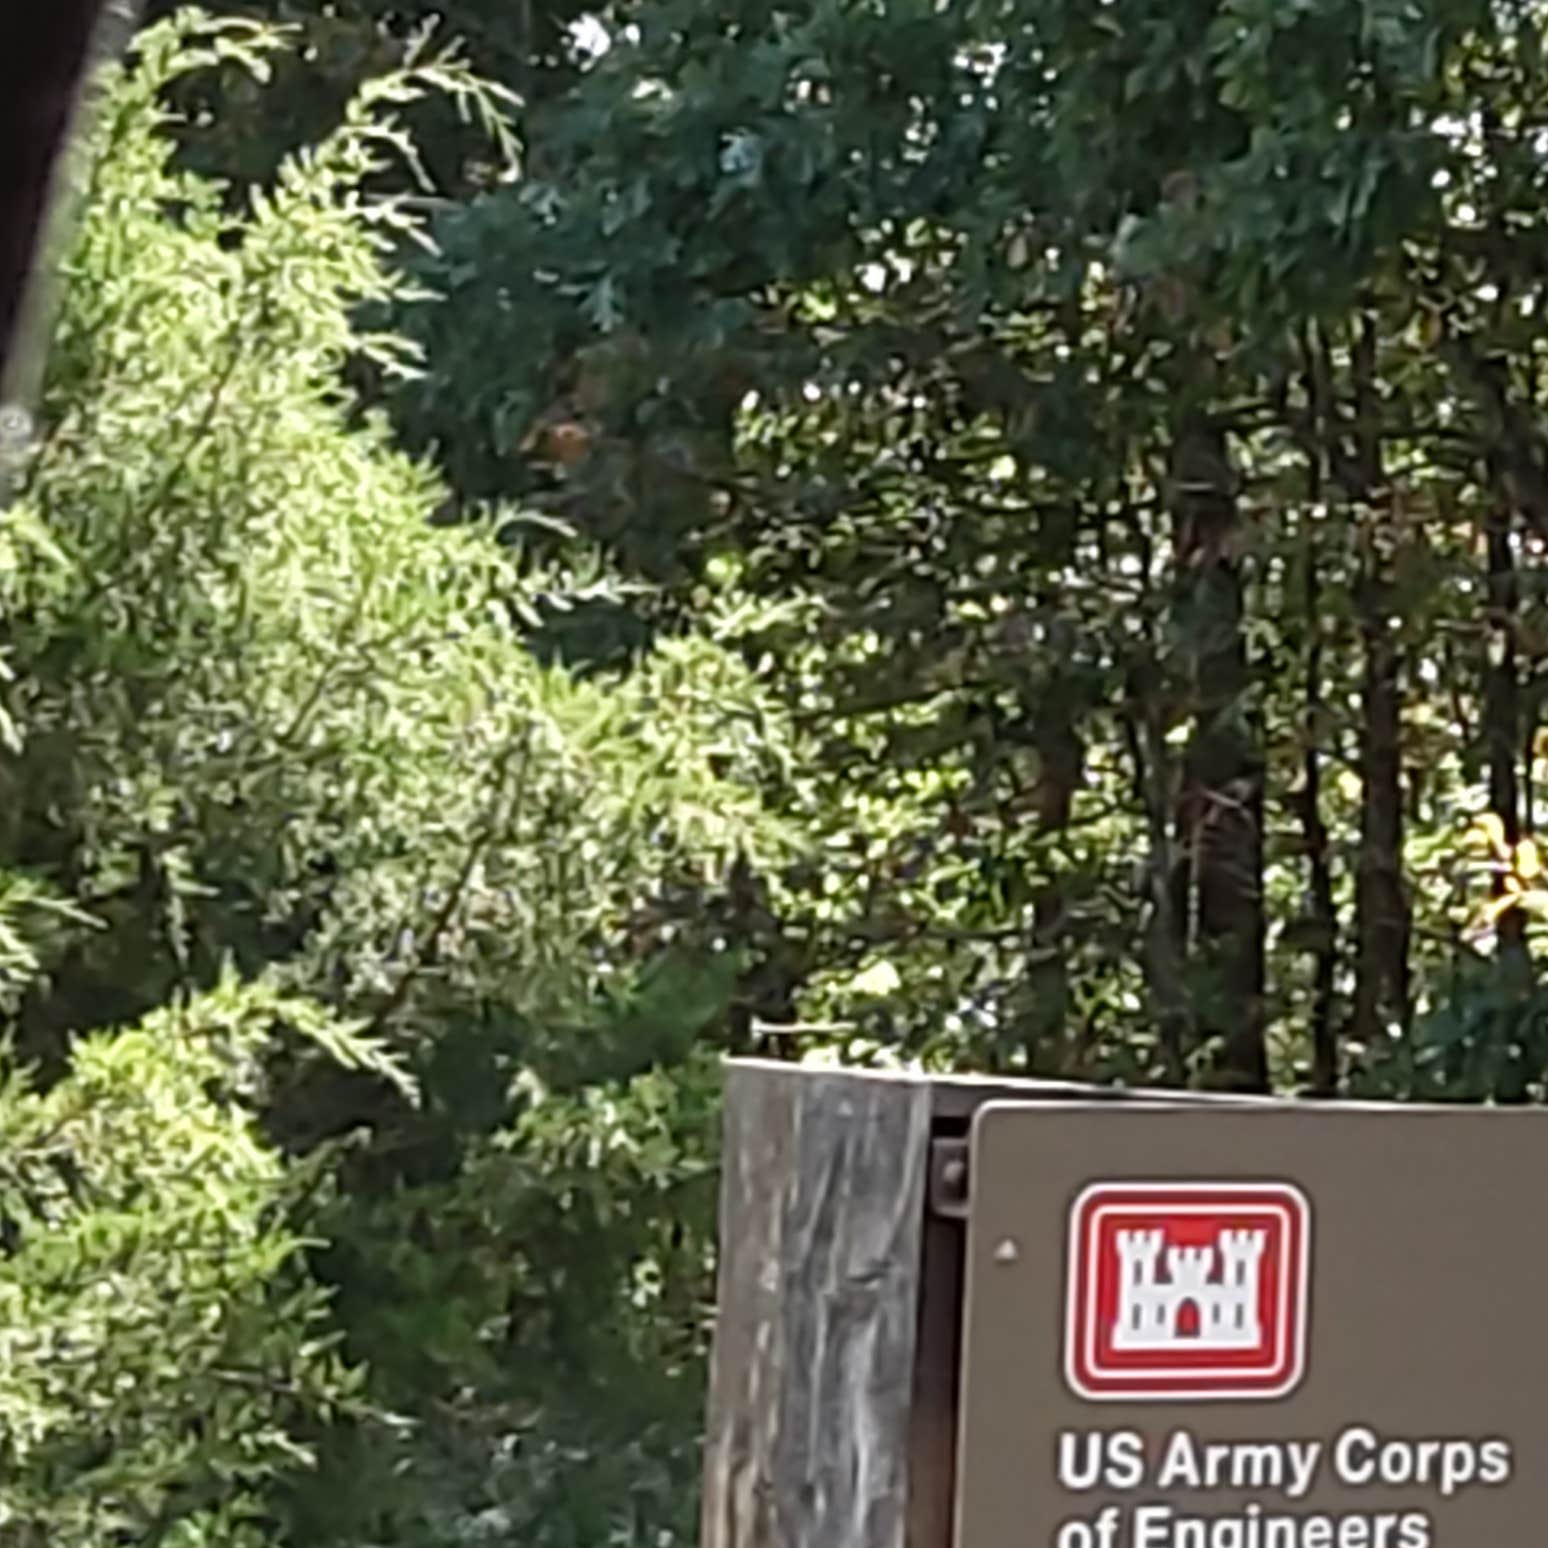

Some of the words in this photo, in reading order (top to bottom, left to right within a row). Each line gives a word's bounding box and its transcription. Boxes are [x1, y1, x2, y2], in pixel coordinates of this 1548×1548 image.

[1059, 1430, 1144, 1489] US
[1157, 1430, 1321, 1497] Army
[1335, 1427, 1510, 1495] Corps
